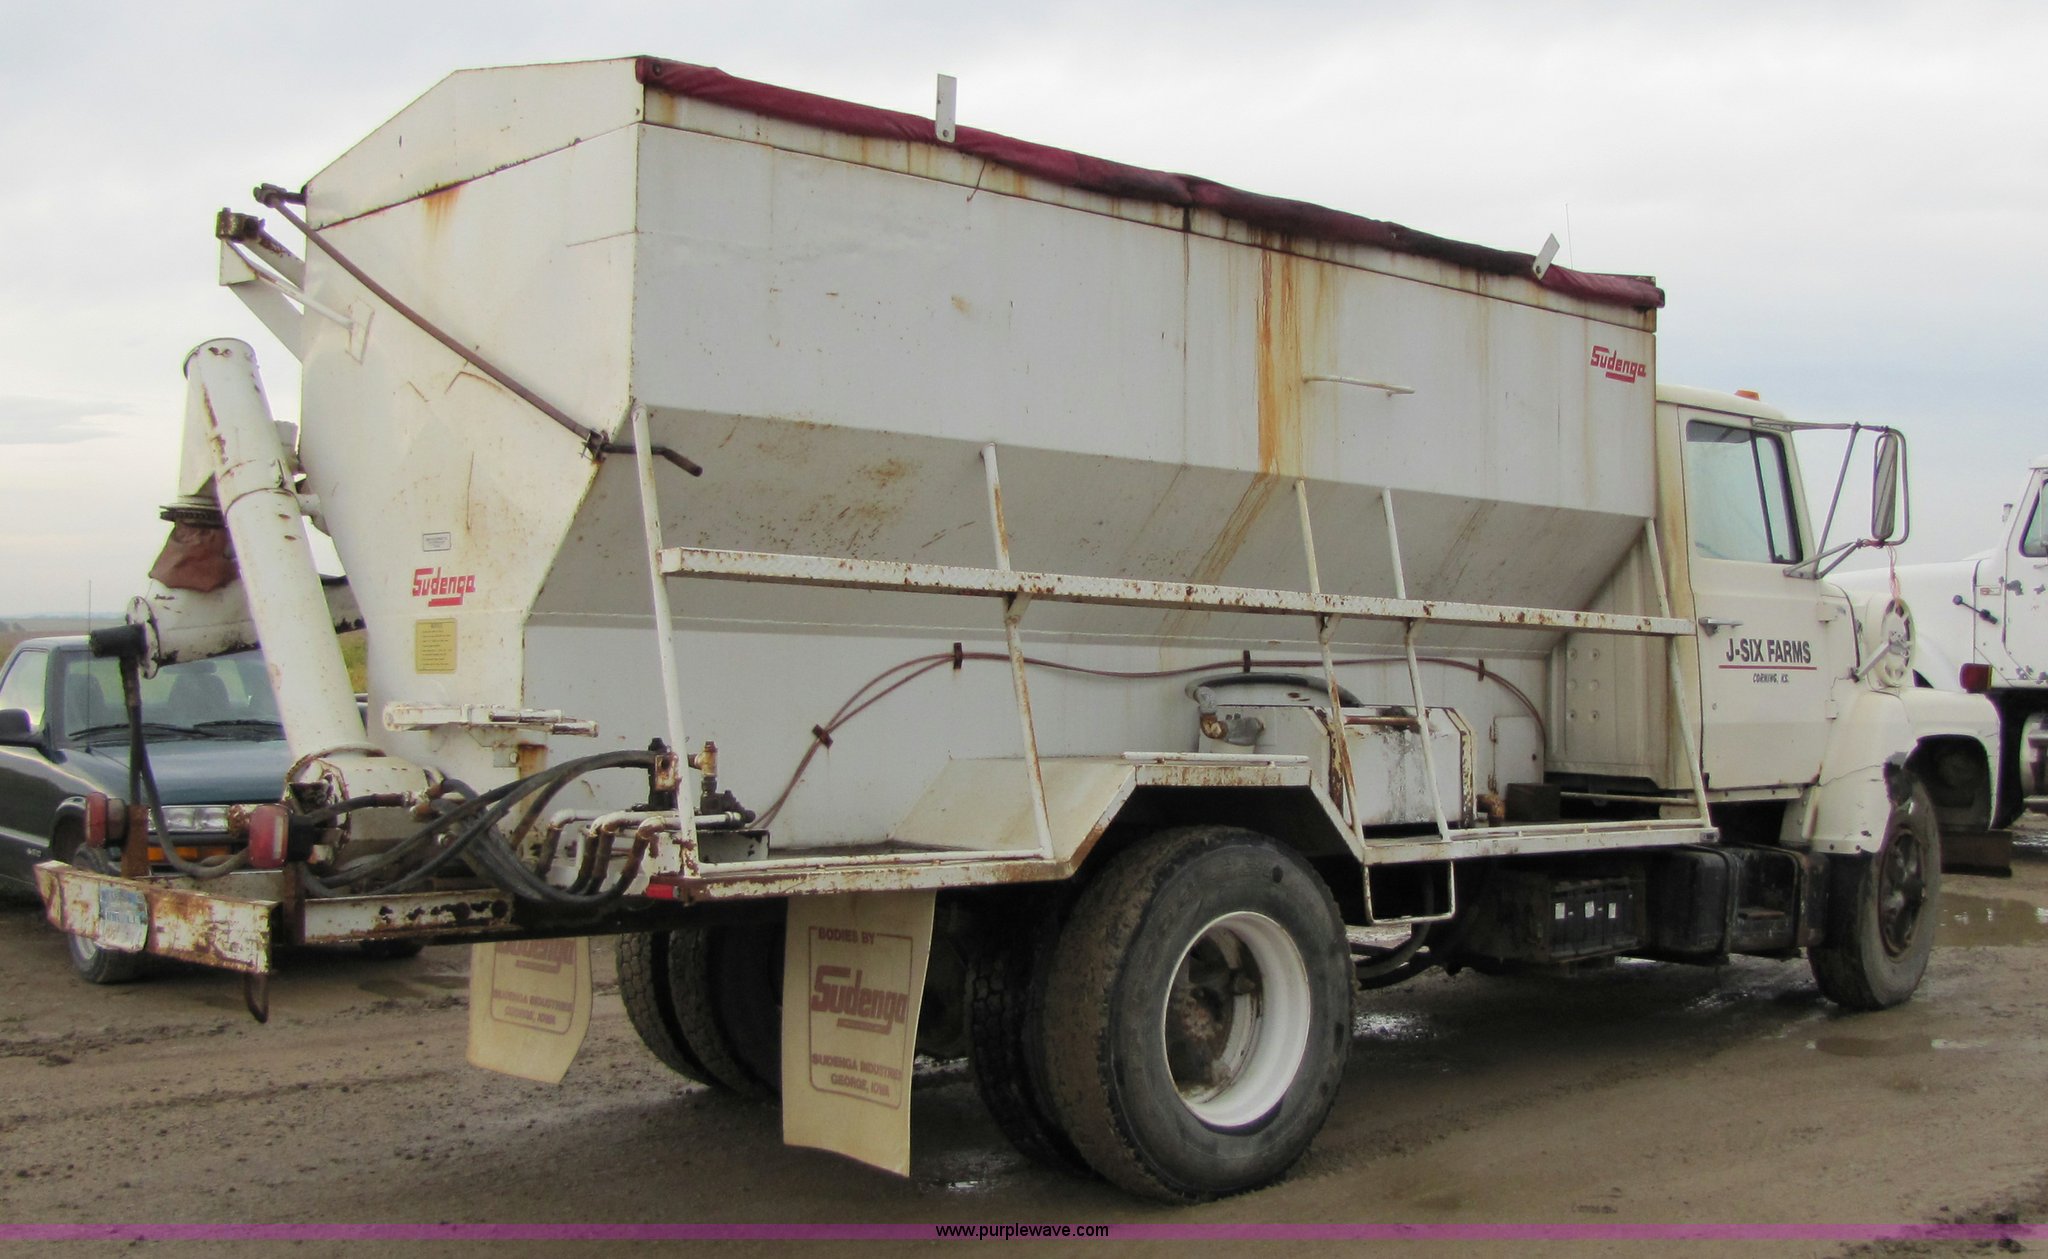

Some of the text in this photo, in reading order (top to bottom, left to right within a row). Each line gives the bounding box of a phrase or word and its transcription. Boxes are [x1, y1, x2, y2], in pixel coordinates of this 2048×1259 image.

[1591, 345, 1646, 383] Sudenga
[412, 567, 476, 607] Sudenga
[1726, 638, 1811, 664] J-SIX FARMS
[861, 931, 875, 945] BY
[811, 965, 908, 1035] Sudenga
